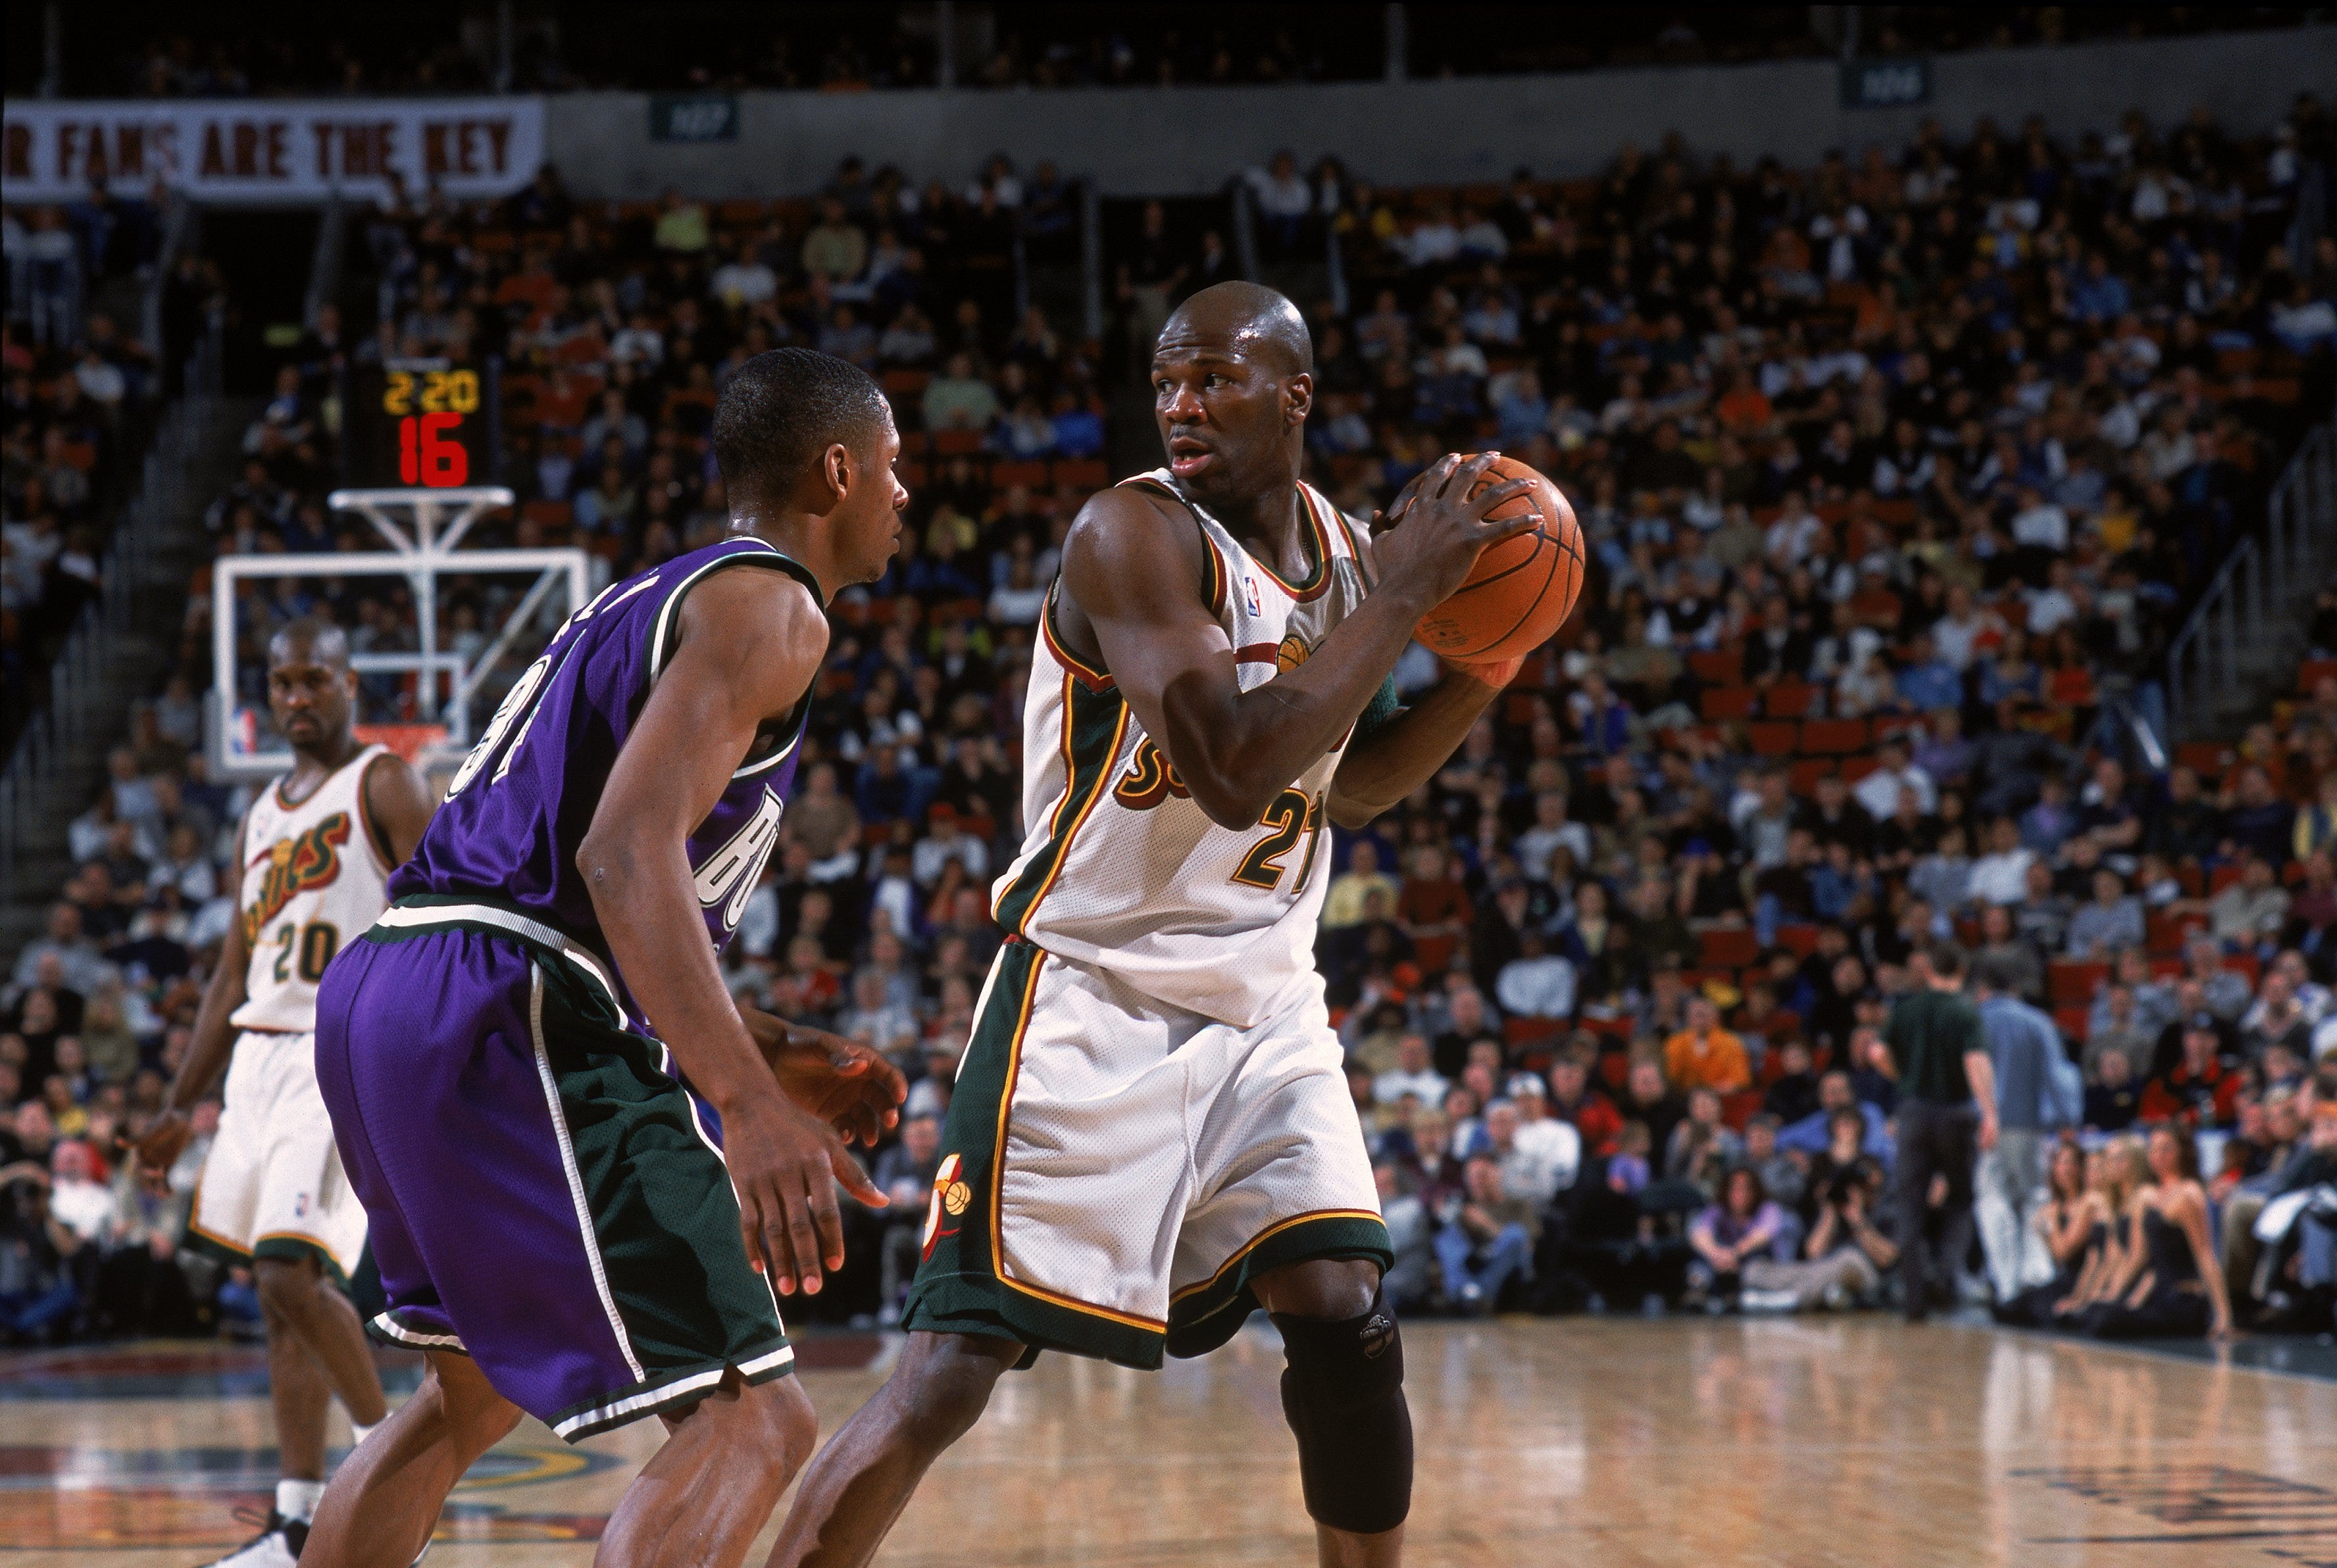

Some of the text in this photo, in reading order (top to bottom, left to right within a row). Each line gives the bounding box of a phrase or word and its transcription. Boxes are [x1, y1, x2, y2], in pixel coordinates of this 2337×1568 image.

[201, 121, 289, 176] ARE
[312, 118, 398, 176] THE
[425, 118, 515, 176] KEY
[400, 412, 468, 487] 16
[274, 920, 341, 984] 20
